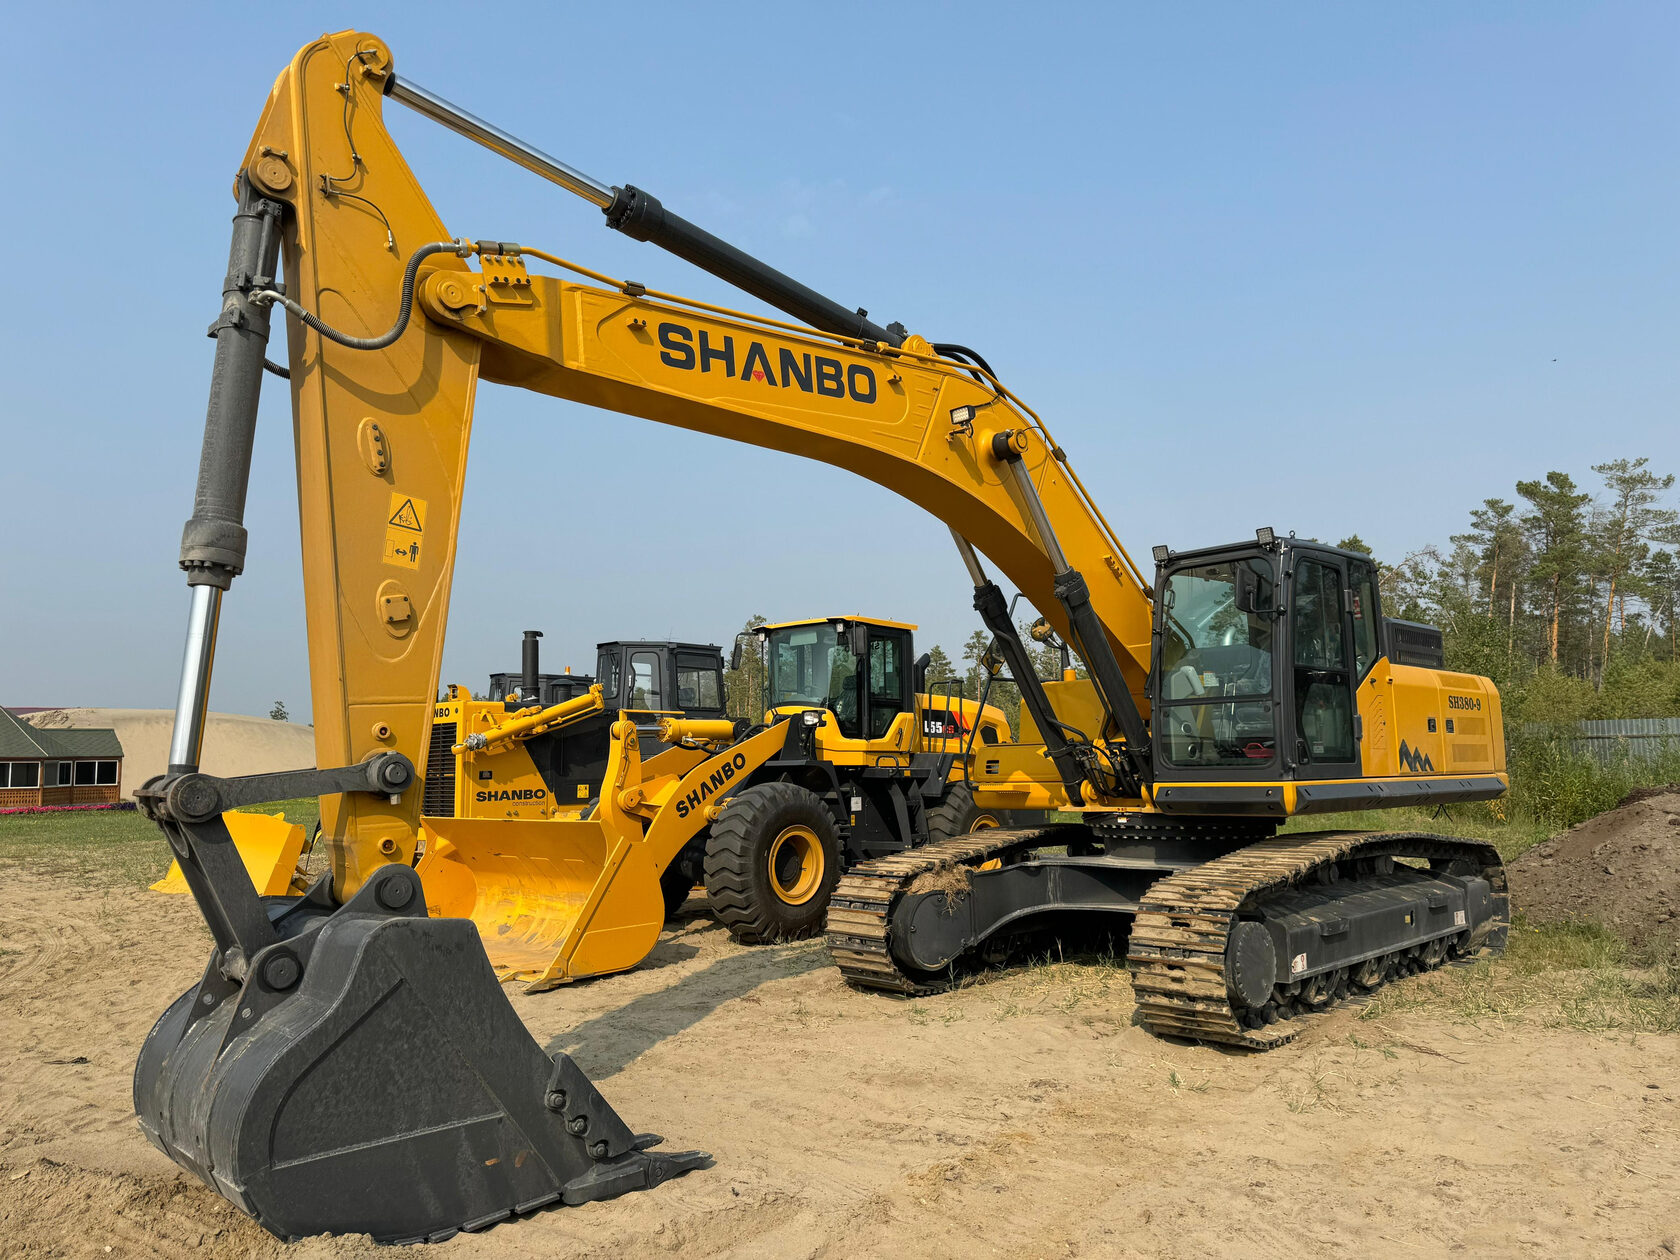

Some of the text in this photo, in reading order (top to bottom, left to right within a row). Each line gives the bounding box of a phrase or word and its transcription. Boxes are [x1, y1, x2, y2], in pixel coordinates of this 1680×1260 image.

[658, 322, 877, 404] SHANBO
[1448, 695, 1481, 711] SH380-9
[476, 789, 546, 802] SHANBO
[676, 753, 746, 818] SHANBO
